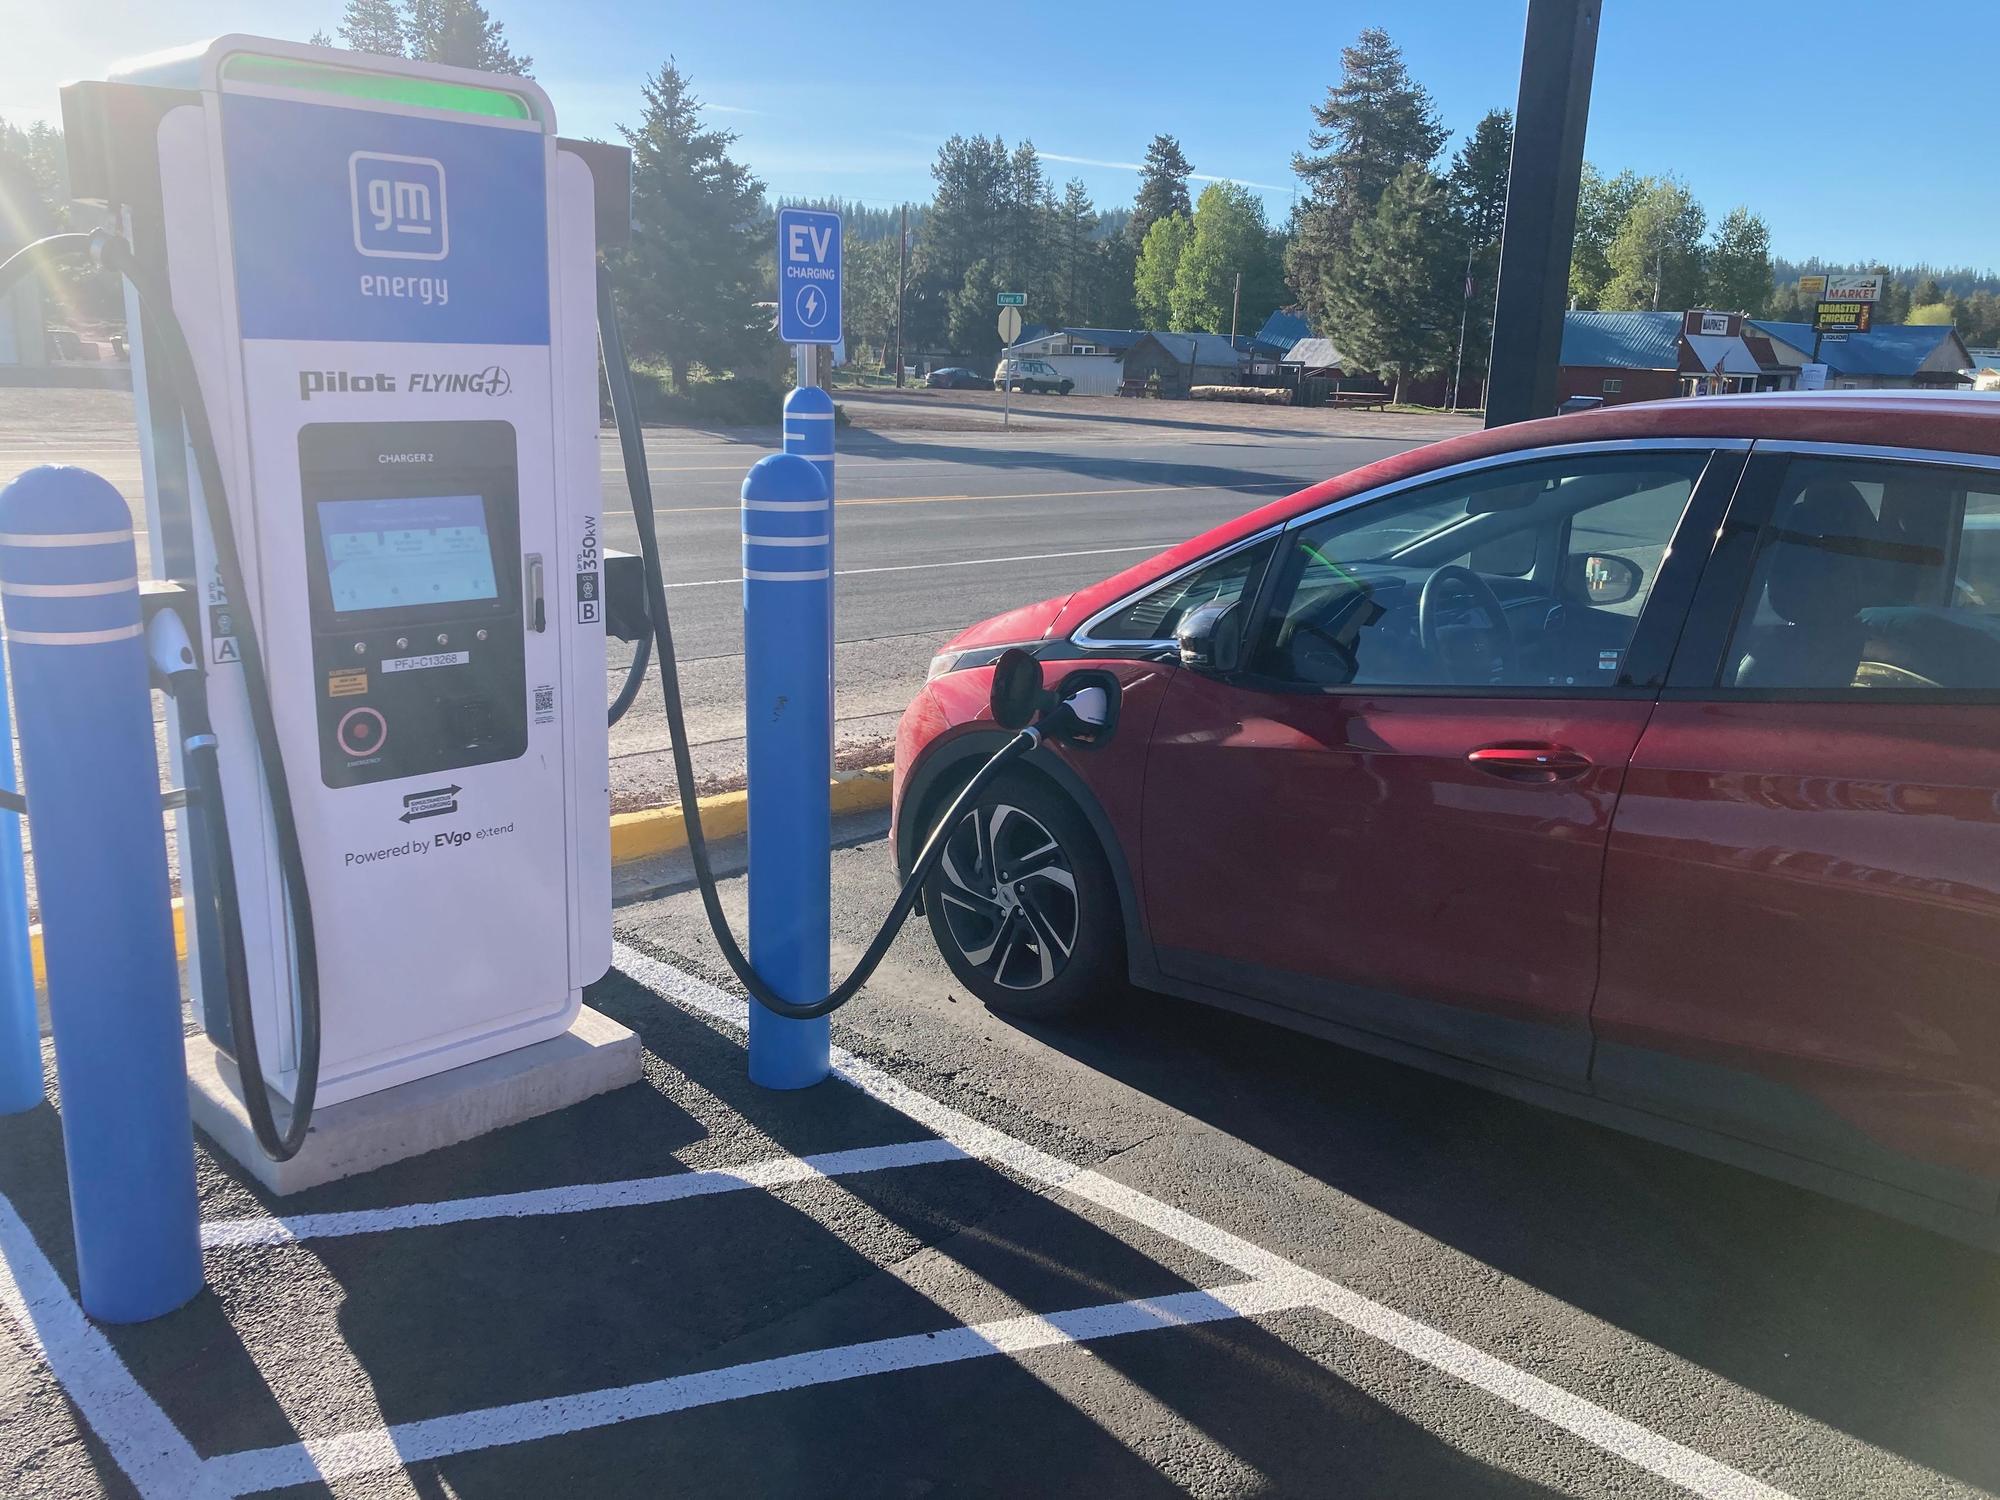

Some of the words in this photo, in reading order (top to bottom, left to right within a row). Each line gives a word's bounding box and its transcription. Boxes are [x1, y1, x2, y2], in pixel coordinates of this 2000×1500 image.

[368, 179, 431, 232] gm
[789, 224, 832, 263] EV
[787, 266, 835, 280] CHARGING
[360, 274, 449, 306] energy
[1828, 289, 1877, 299] MARKET
[1703, 317, 1726, 331] MARKET
[1820, 313, 1856, 323] CHICKEN
[408, 373, 484, 393] FLYING
[378, 453, 426, 464] CHARGER
[427, 452, 434, 462] 2
[582, 515, 597, 570] 350kW
[583, 603, 595, 620] B
[218, 639, 237, 660] A
[394, 653, 458, 670] PFJ-C13268
[410, 795, 452, 807] SIMULTANEOUS
[420, 800, 452, 811] CHARGING
[344, 840, 410, 867] Powered
[413, 840, 431, 854] by
[434, 830, 472, 848] EVgo
